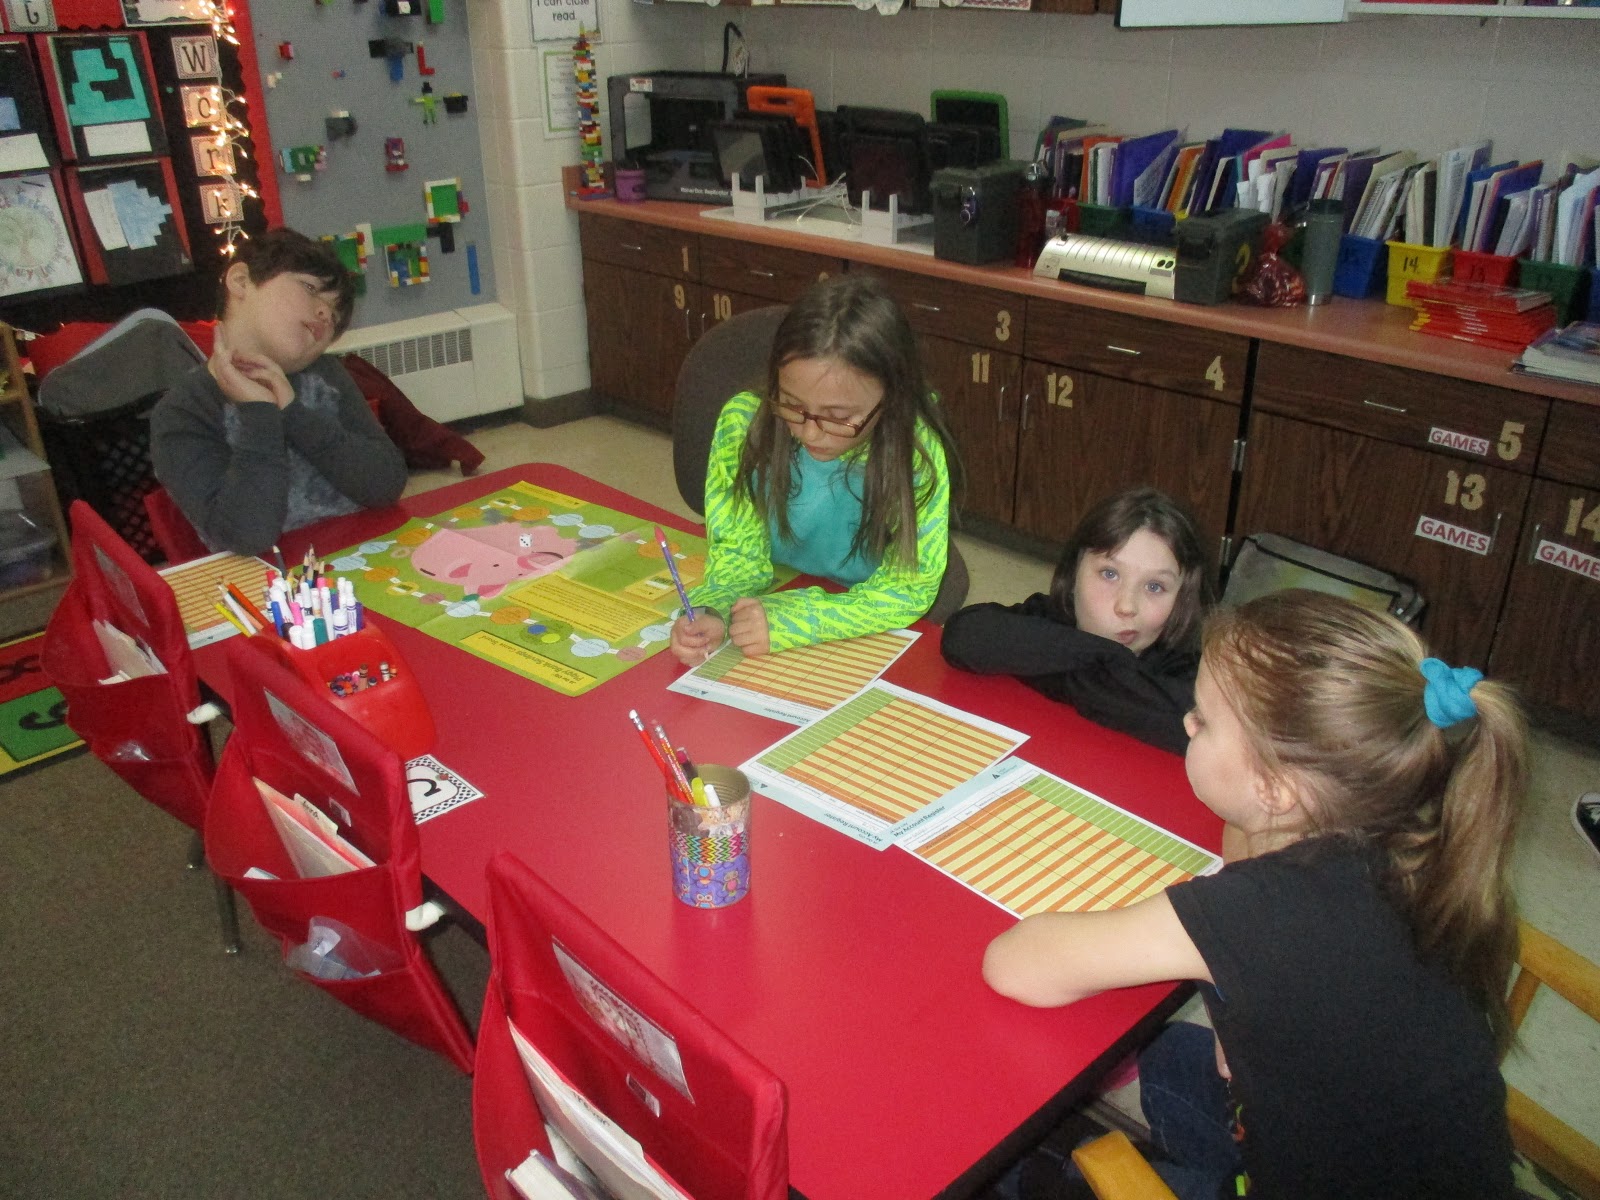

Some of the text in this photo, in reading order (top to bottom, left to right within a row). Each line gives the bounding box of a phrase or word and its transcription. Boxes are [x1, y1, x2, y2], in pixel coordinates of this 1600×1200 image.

[682, 247, 690, 273] 1
[1402, 256, 1419, 273] 14
[673, 284, 686, 310] 9
[713, 293, 732, 321] 10
[995, 310, 1012, 342] 3
[971, 352, 991, 384] 11
[1205, 355, 1226, 392] 4
[1047, 372, 1074, 409] 12
[1430, 429, 1489, 455] GAMES
[1496, 420, 1526, 461] 5
[1444, 469, 1487, 511] 13
[1420, 519, 1490, 552] GAMES
[824, 812, 849, 826] Register
[847, 823, 872, 838] Account
[903, 817, 925, 832] Account
[922, 806, 946, 820] Register
